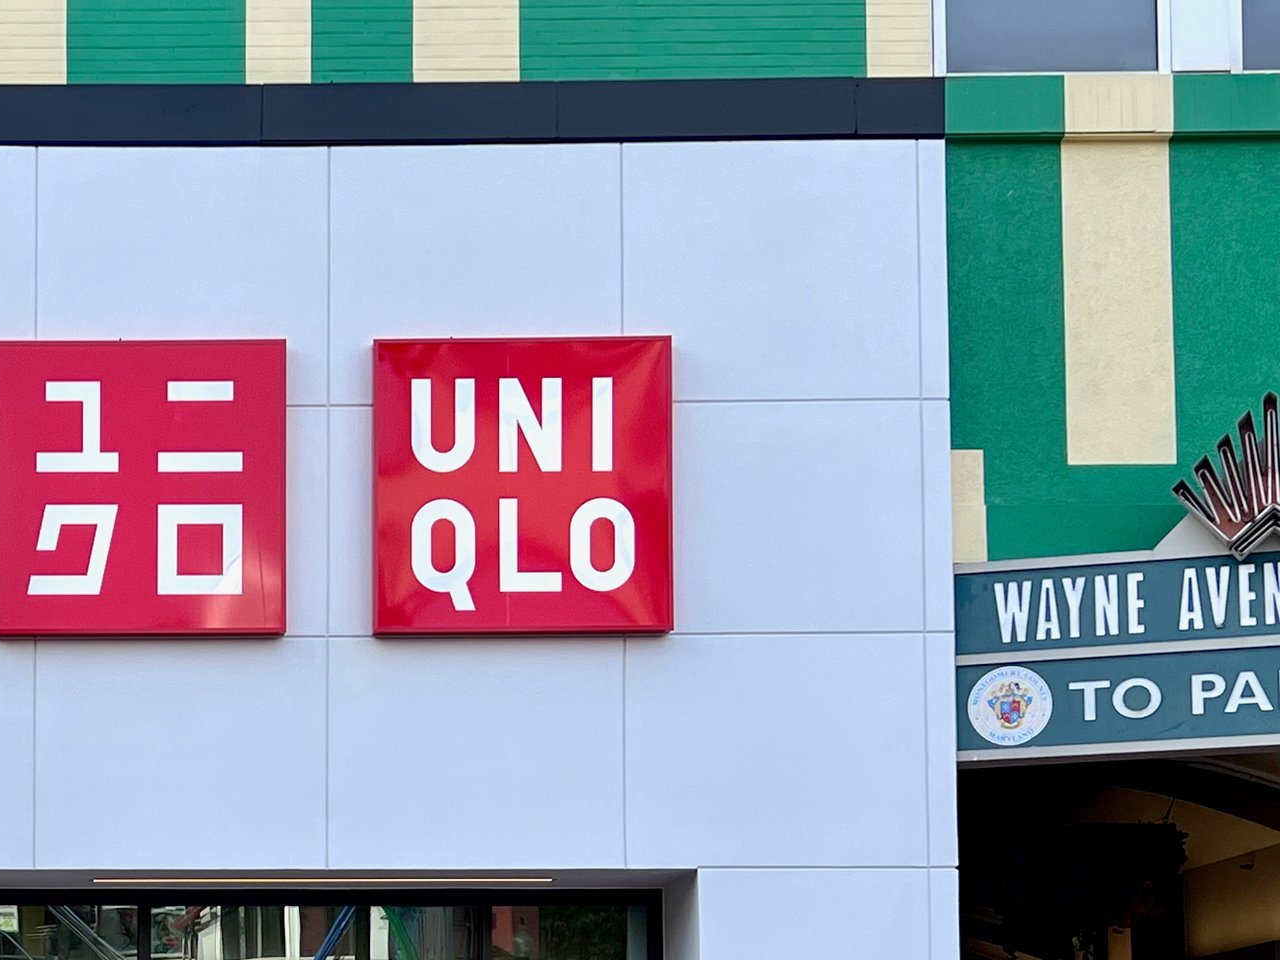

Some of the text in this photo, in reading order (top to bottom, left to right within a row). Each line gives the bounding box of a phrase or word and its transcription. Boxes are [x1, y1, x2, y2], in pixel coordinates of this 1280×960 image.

[35, 380, 243, 472] ユニ
[411, 377, 613, 472] UNI
[26, 504, 243, 595] クロ
[411, 497, 635, 611] QLO
[993, 562, 1280, 644] WAYNE AVEN
[1068, 669, 1280, 722] TO PA
